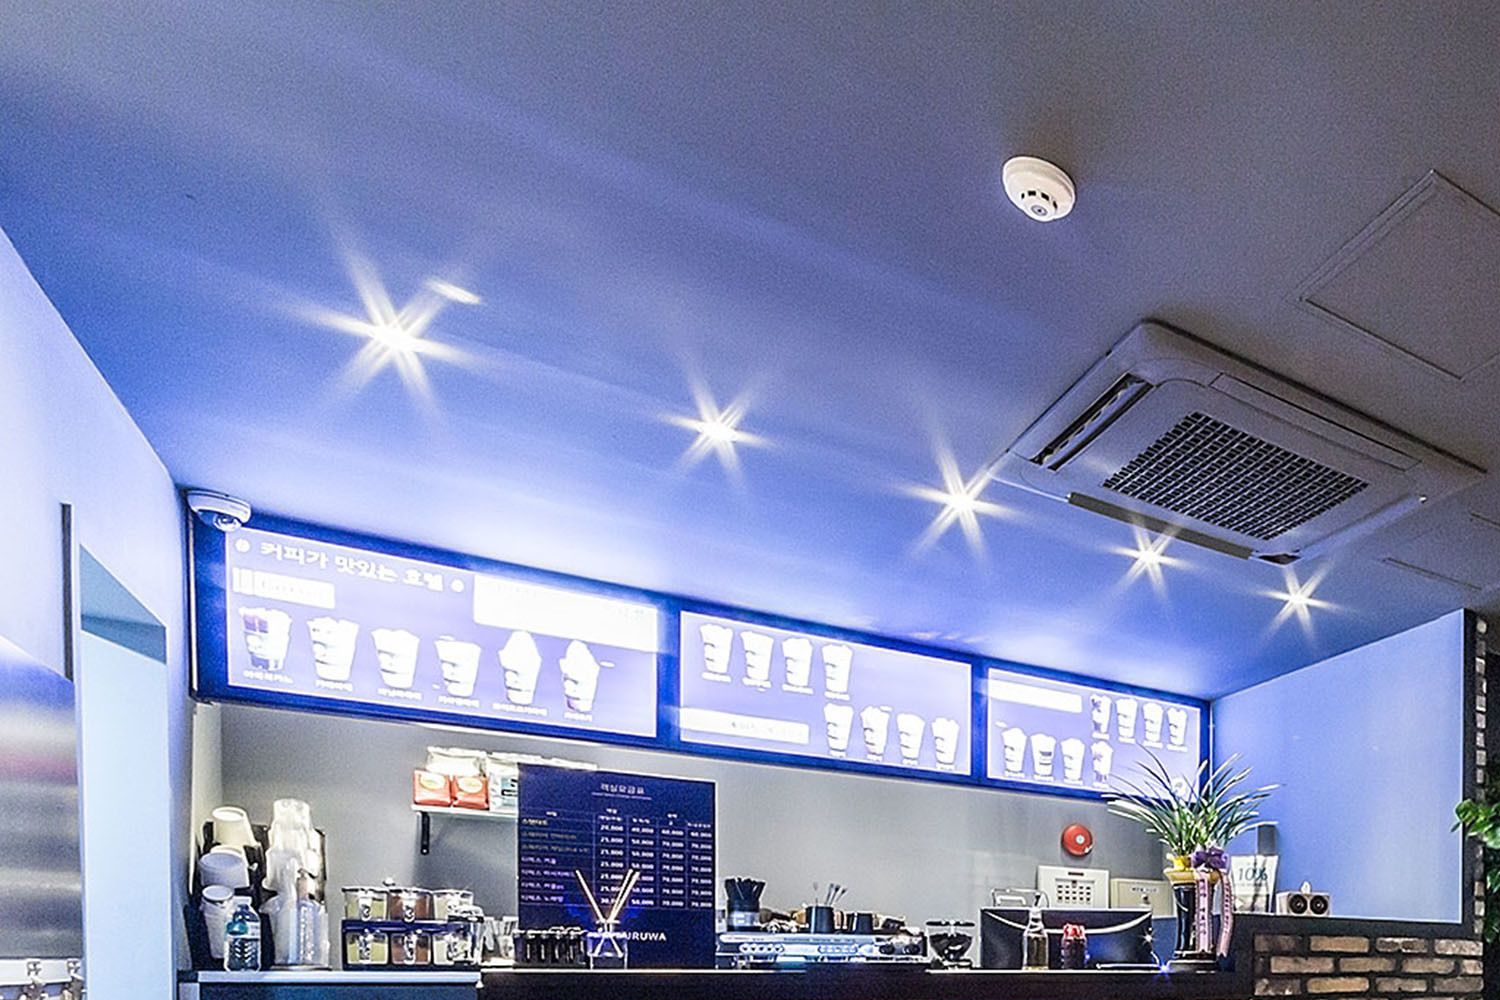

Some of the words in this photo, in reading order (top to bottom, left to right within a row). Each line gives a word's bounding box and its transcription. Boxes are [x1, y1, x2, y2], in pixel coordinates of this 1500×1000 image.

[260, 541, 328, 569] 커피가
[334, 555, 398, 583] 맛있는
[402, 568, 443, 592] 호텔
